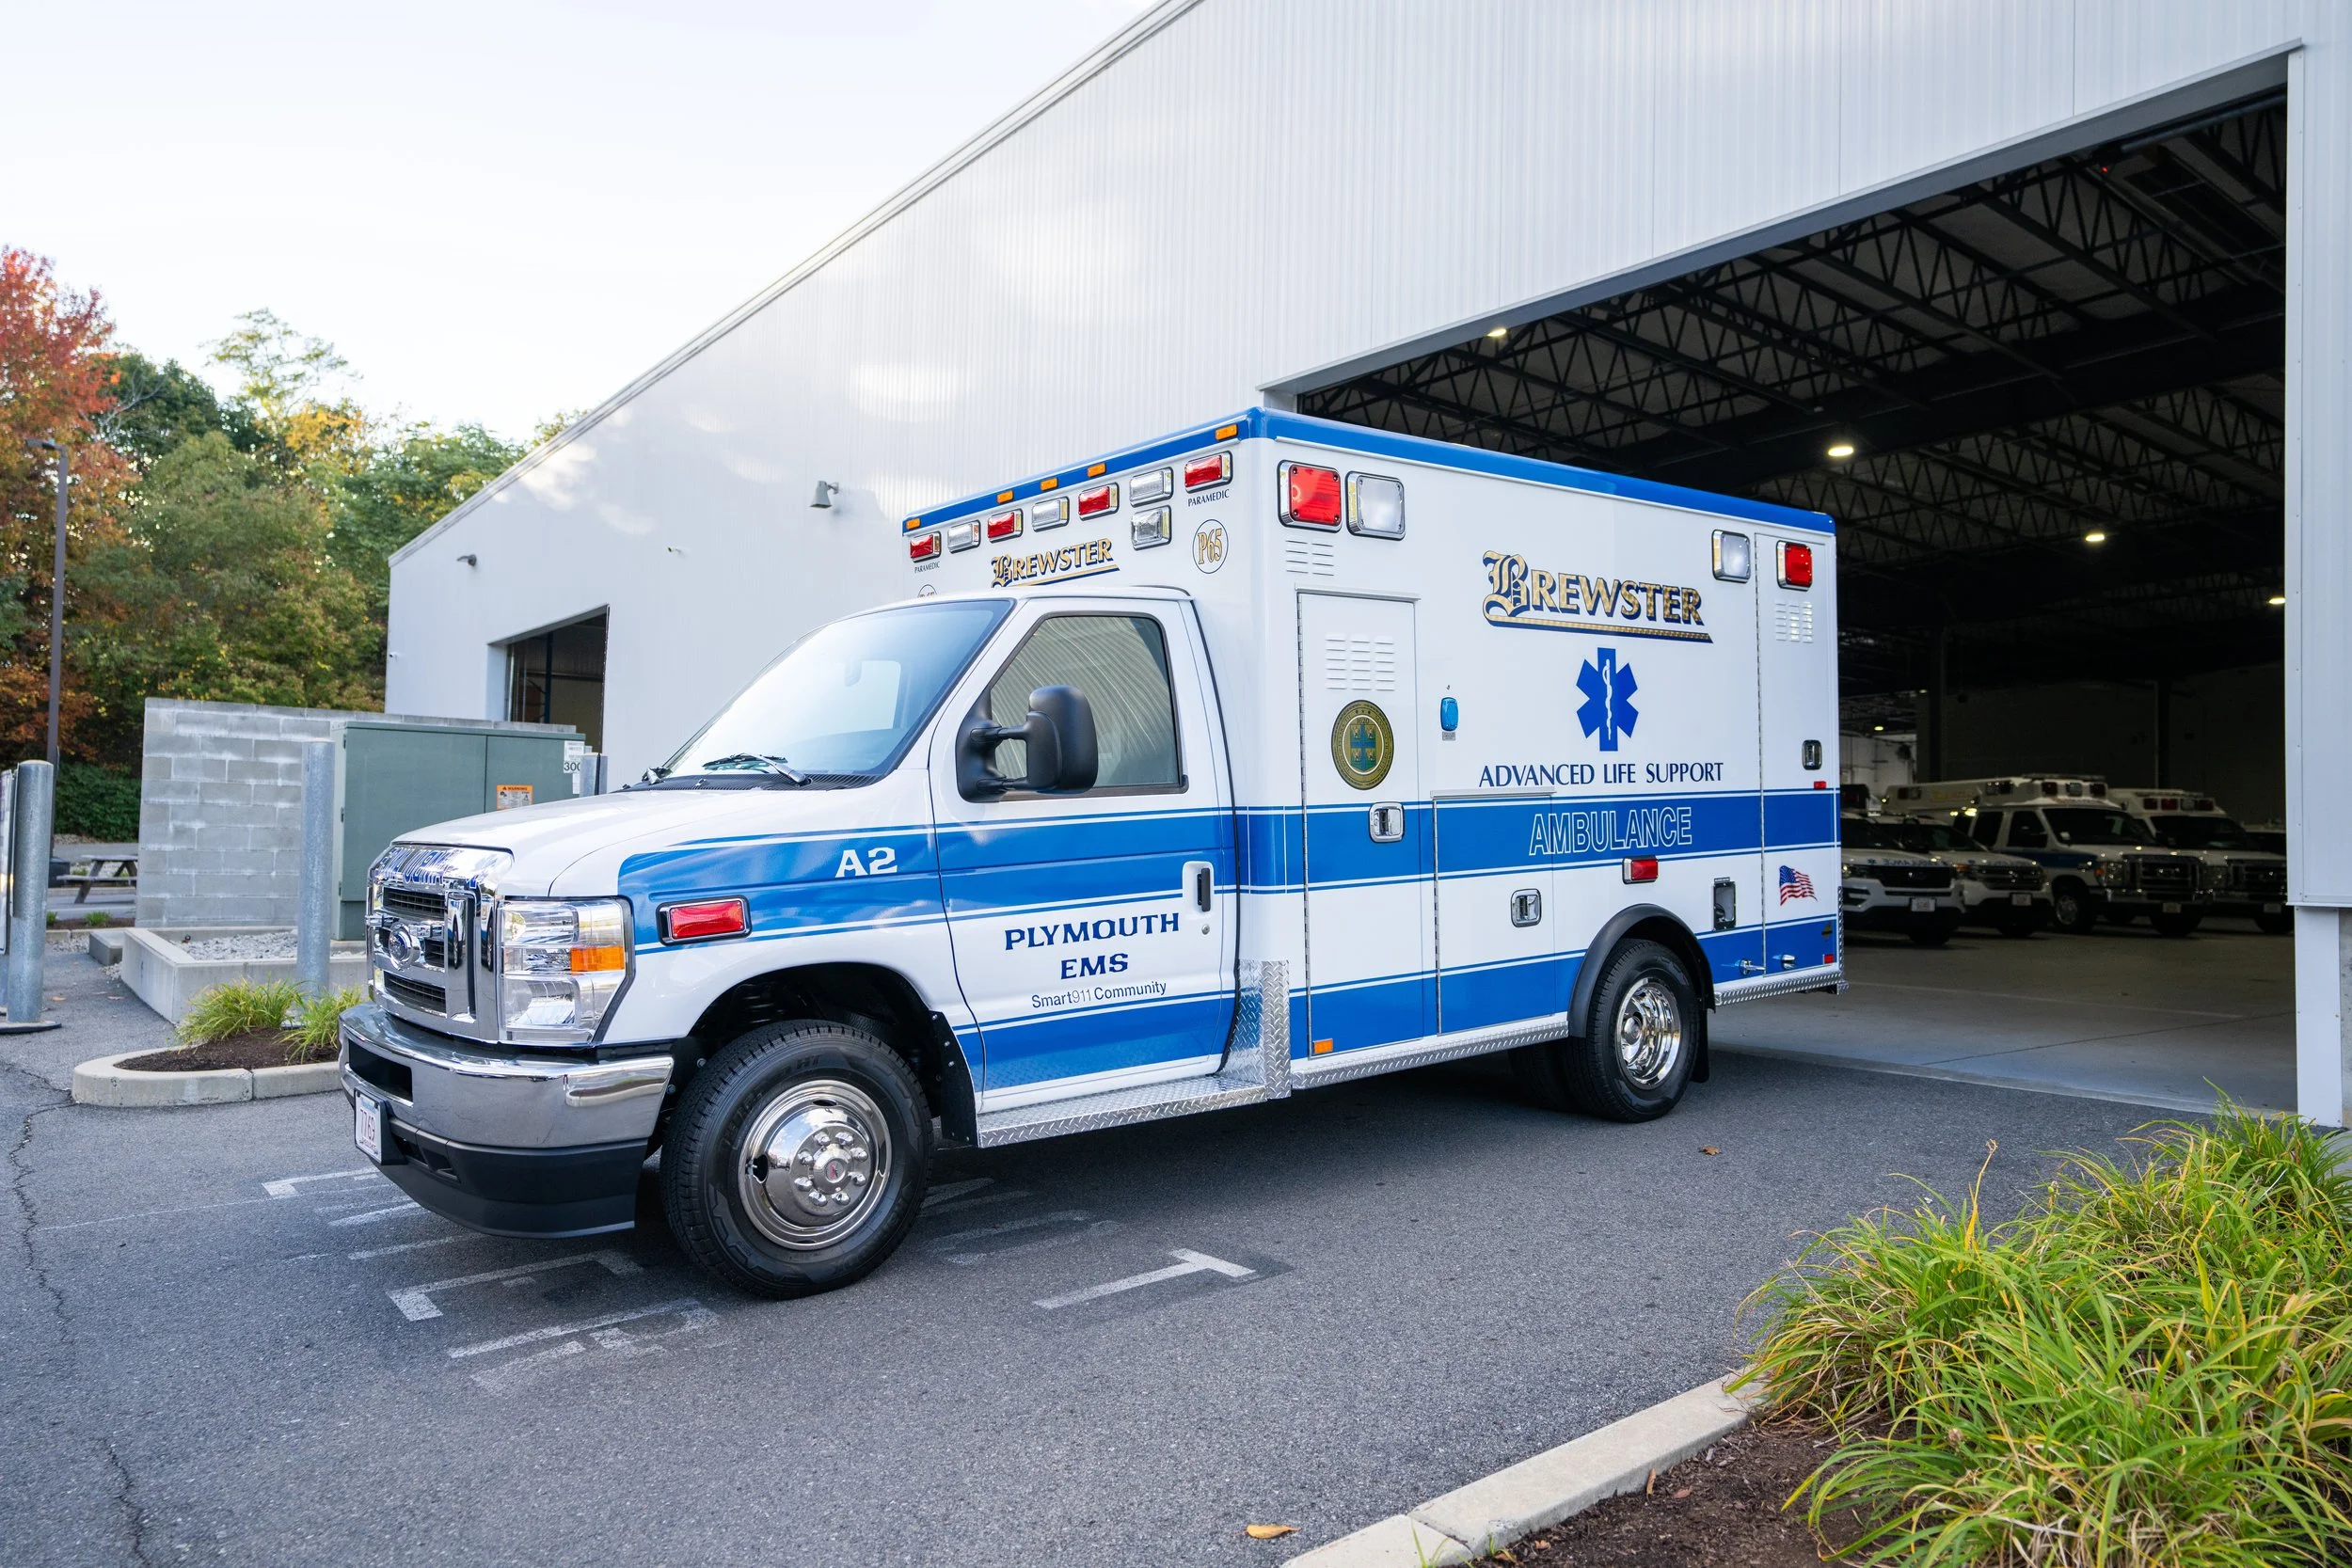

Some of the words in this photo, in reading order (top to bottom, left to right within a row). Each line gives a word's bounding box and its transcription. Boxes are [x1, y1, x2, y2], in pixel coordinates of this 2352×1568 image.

[1187, 489, 1230, 507] PARAMEDIC
[1198, 528, 1223, 565] P65
[914, 562, 941, 574] PARAMEDIC
[991, 537, 1114, 588] BREWSTER
[1483, 550, 1705, 626] BREWSTER
[1479, 764, 1596, 787] ADVANCED
[1603, 763, 1637, 784] LIFE
[1645, 762, 1724, 784] SUPPORT
[1529, 807, 1692, 856] AMBULANCE
[835, 847, 898, 878] A2
[1005, 912, 1180, 951] PLYMOUTH
[1060, 953, 1129, 979] EMS
[1031, 989, 1091, 1008] Smart911
[1094, 981, 1167, 1001] Community
